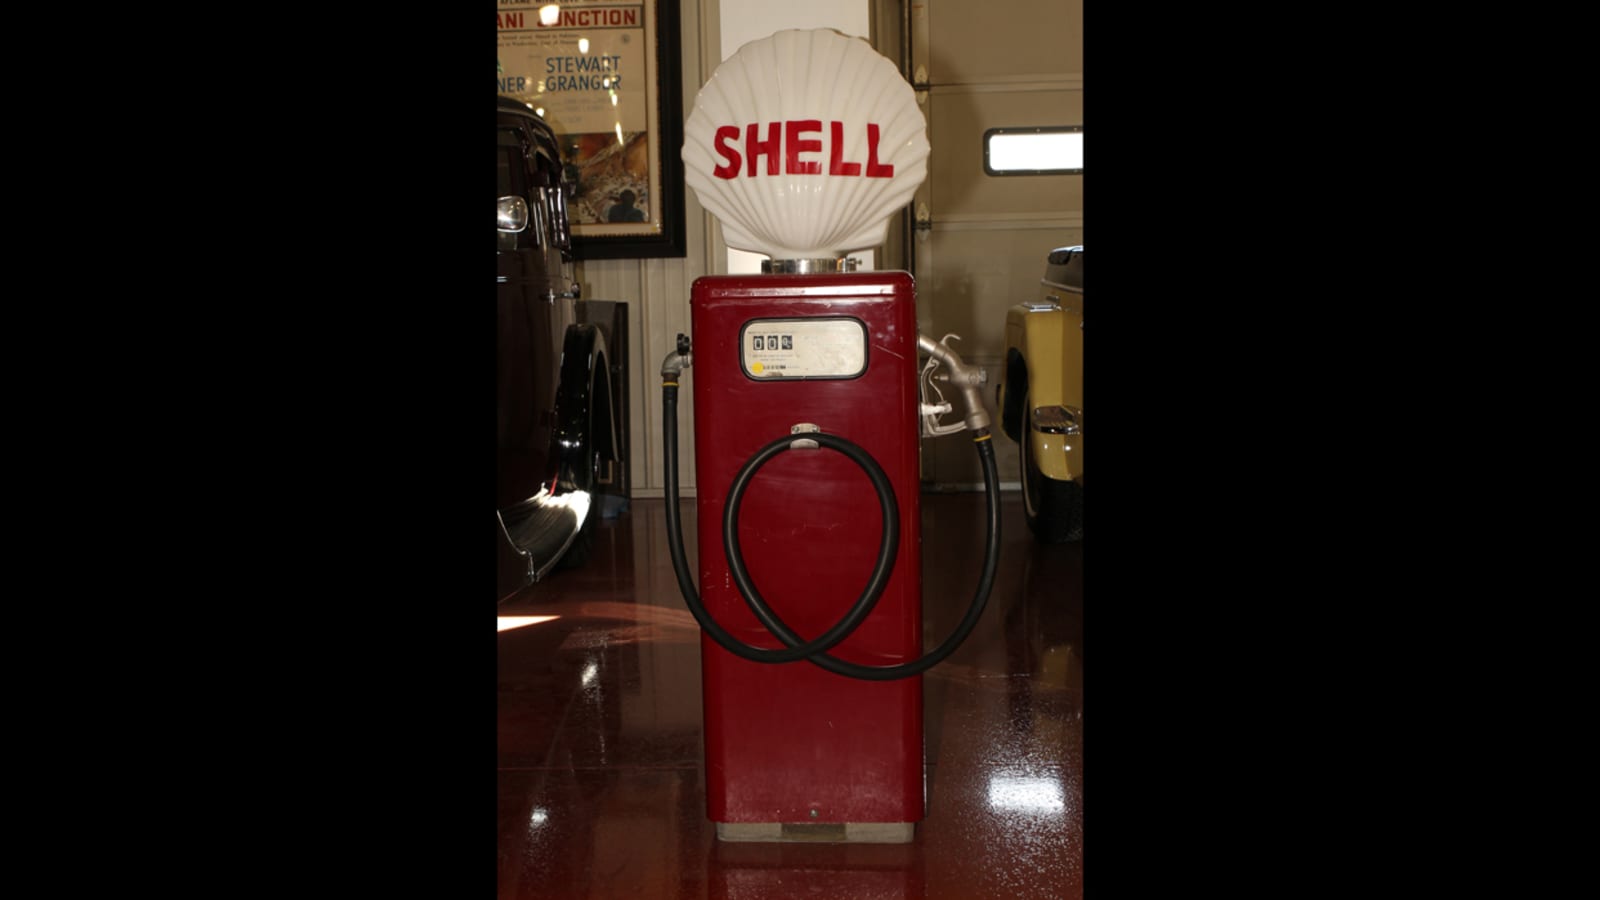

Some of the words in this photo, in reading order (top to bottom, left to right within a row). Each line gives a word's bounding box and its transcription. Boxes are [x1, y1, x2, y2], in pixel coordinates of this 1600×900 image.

[546, 56, 621, 73] STEWART
[545, 75, 622, 91] GRANGER
[713, 119, 894, 180] SHELL
